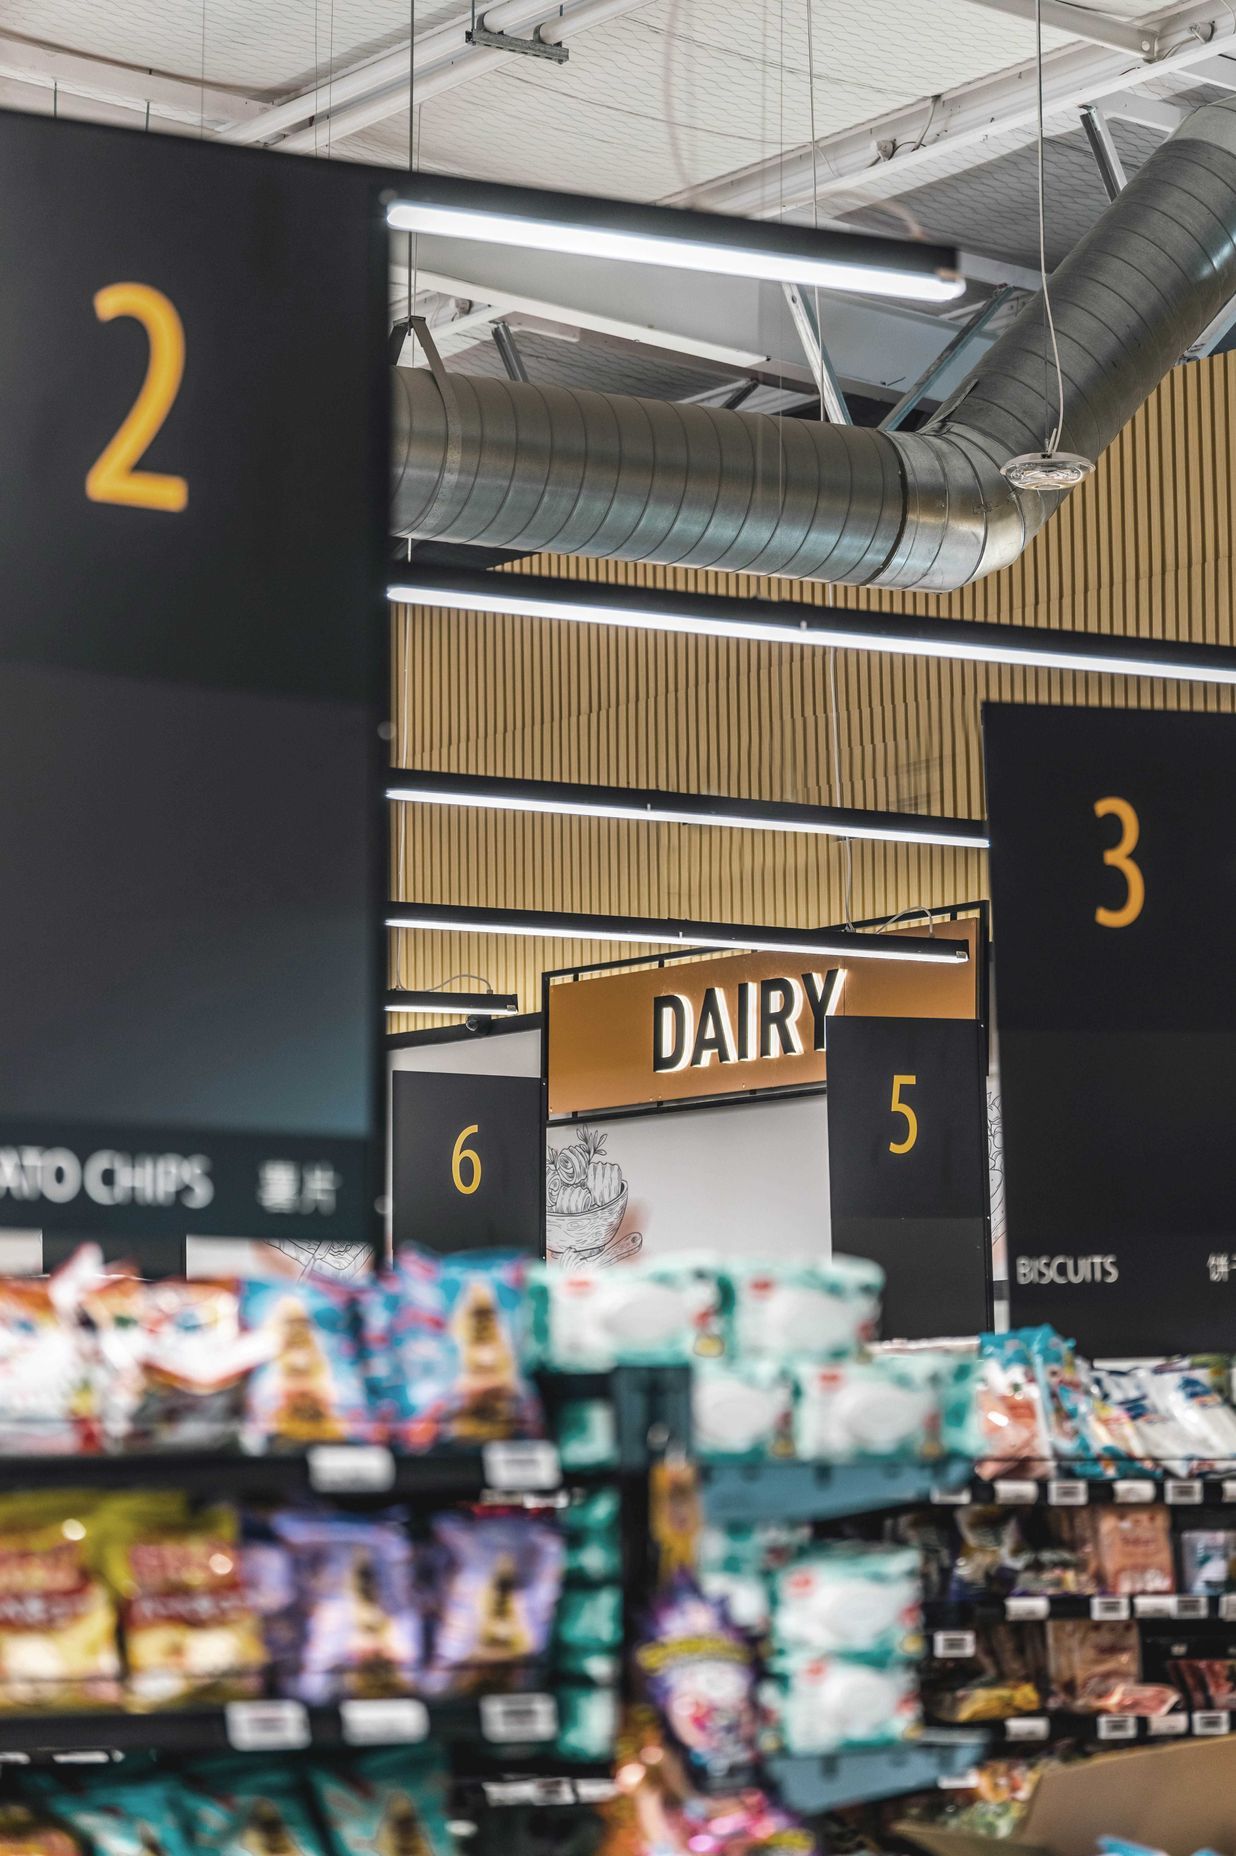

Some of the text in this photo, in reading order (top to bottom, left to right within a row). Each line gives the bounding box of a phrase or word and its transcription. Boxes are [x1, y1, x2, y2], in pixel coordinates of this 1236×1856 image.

[85, 281, 189, 513] 2
[1093, 796, 1145, 928] 3
[653, 968, 847, 1073] DAIRY
[889, 1075, 918, 1154] 5
[83, 1149, 215, 1209] CHIPS
[451, 1124, 482, 1194] 6
[1016, 1254, 1119, 1284] BISCUITS
